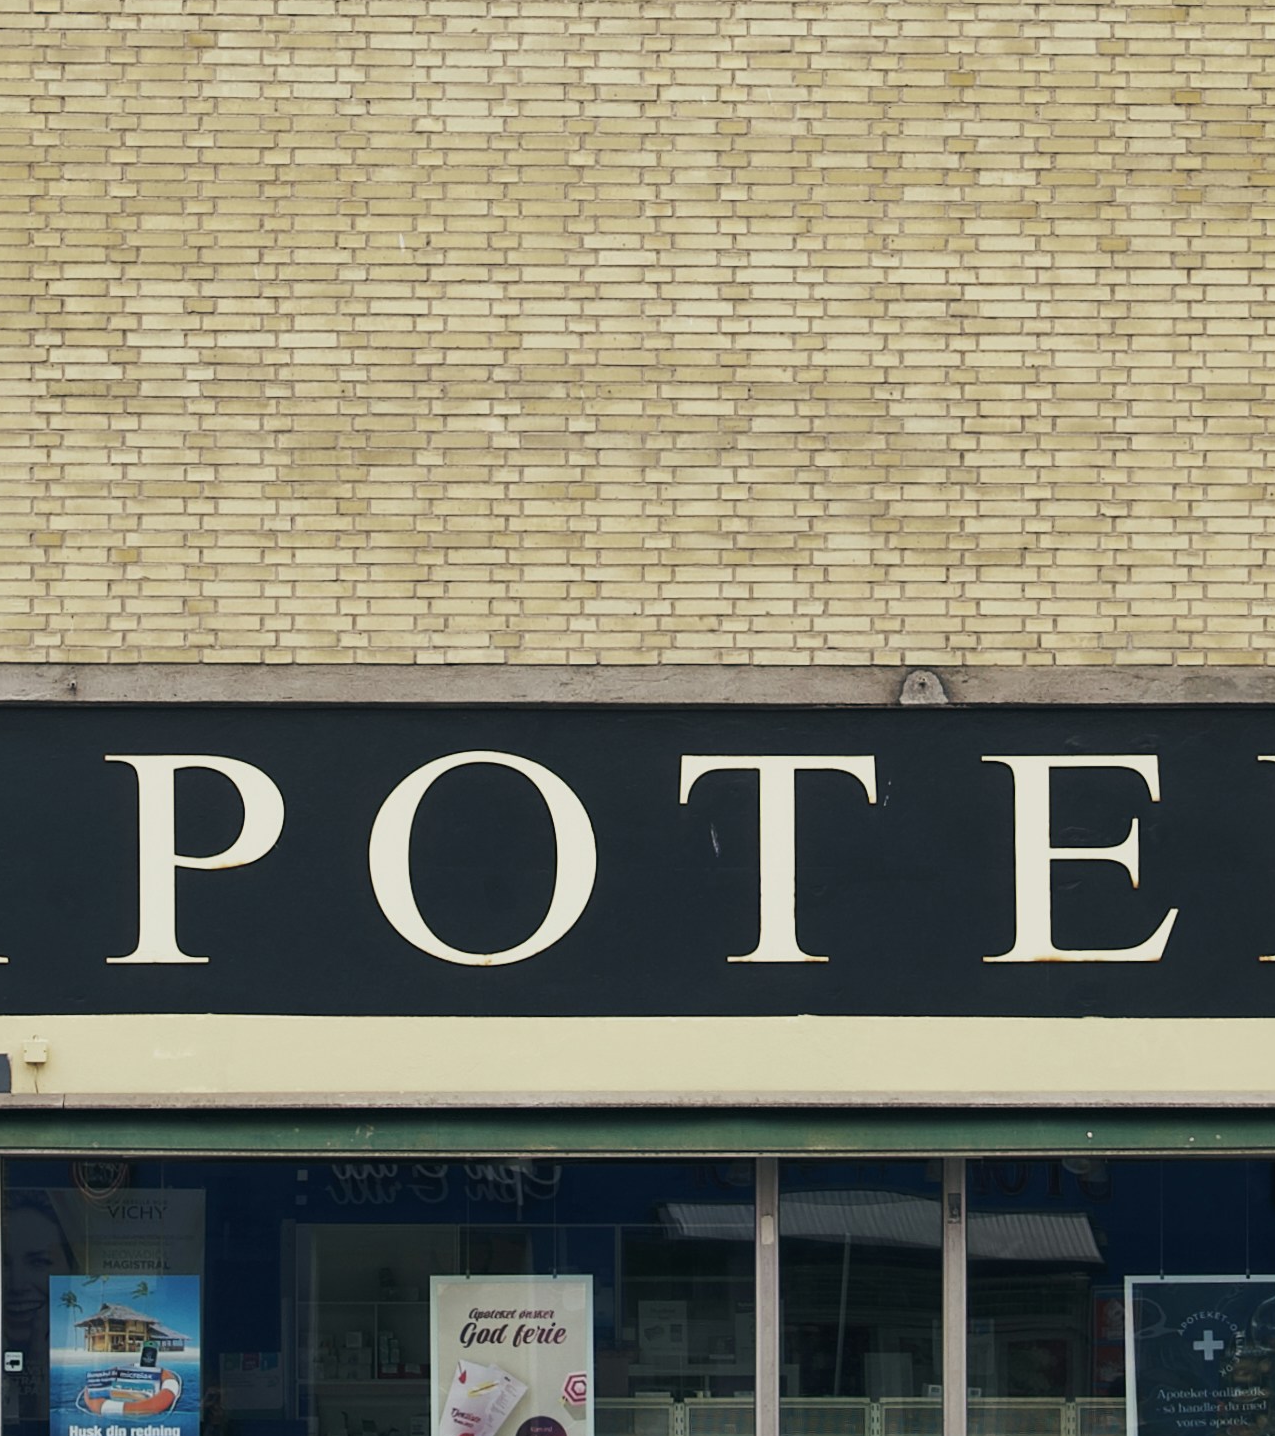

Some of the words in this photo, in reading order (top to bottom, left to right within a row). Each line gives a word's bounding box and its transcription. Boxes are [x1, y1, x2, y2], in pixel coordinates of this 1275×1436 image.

[107, 1205, 167, 1219] VICHY
[103, 1260, 171, 1270] MAGISTRAL
[459, 1322, 509, 1348] God
[512, 1322, 567, 1348] ferie
[1178, 1403, 1222, 1414] handler
[1224, 1401, 1240, 1412] du
[1242, 1400, 1267, 1411] med
[1176, 1418, 1207, 1427] vores
